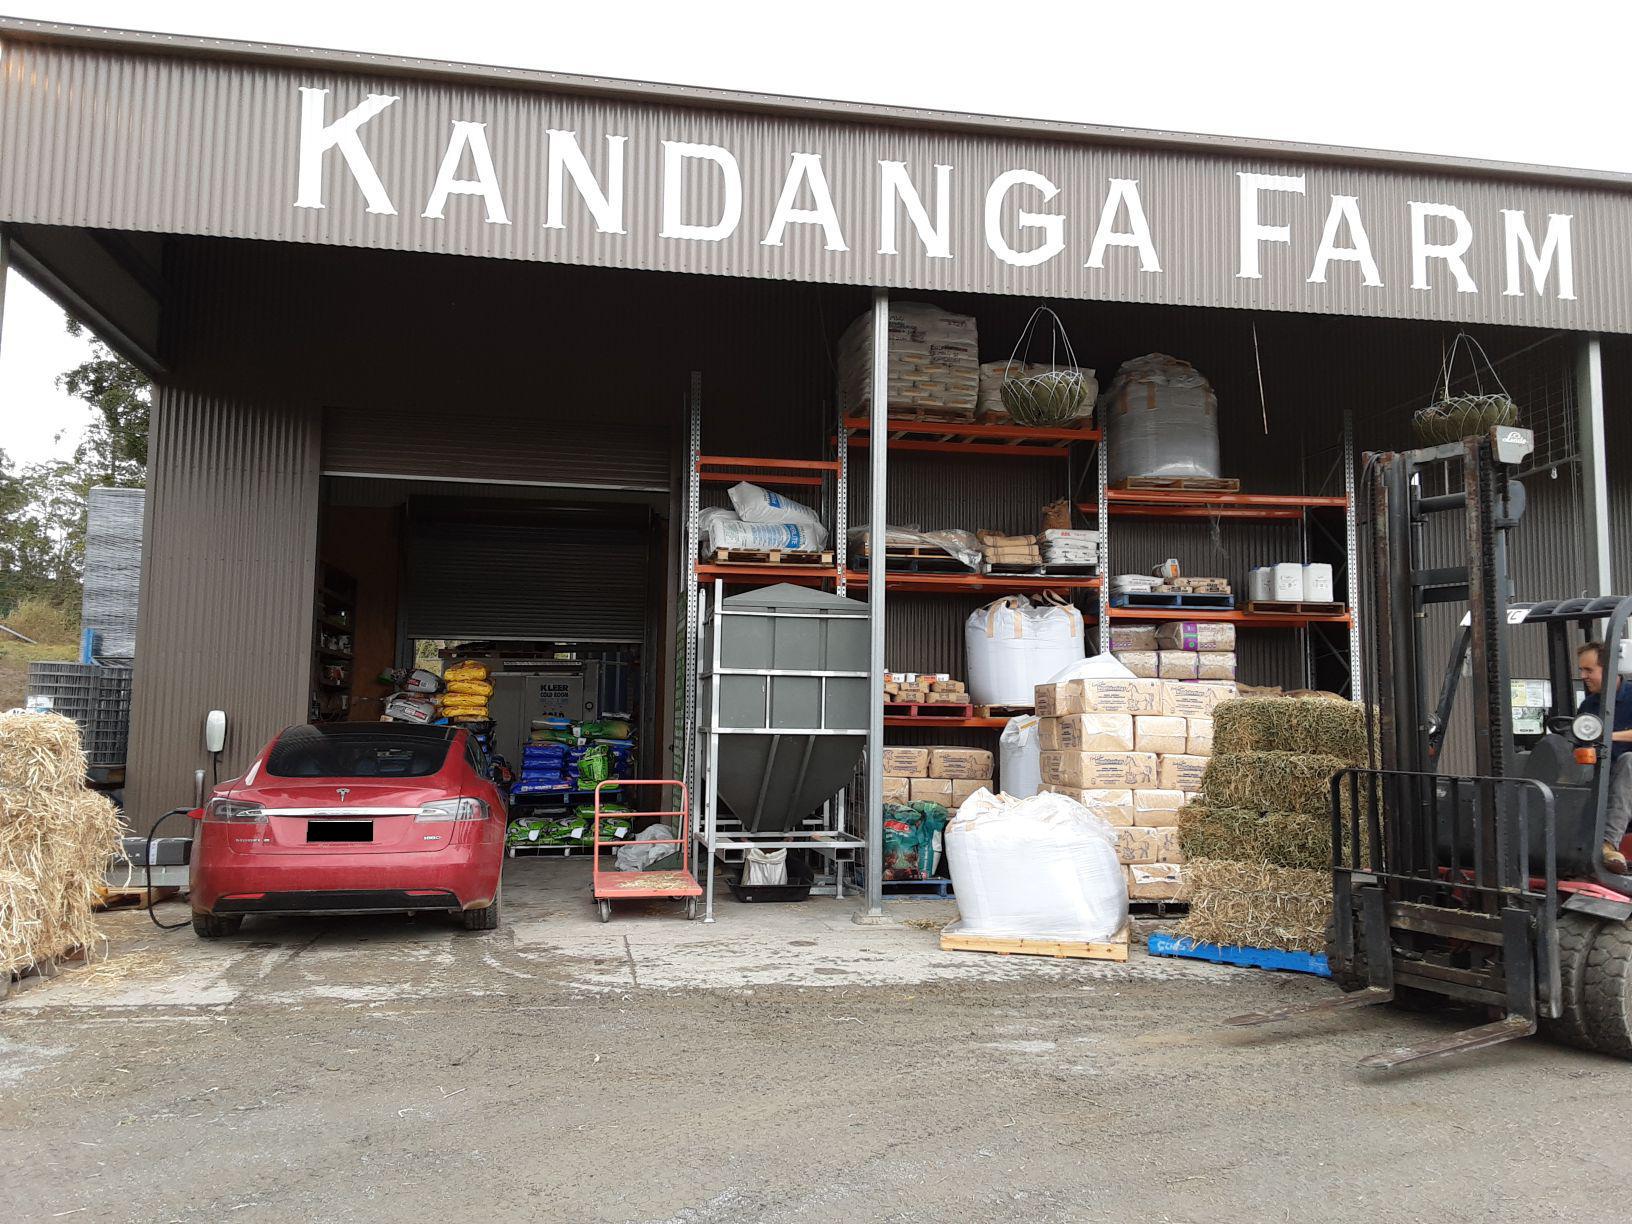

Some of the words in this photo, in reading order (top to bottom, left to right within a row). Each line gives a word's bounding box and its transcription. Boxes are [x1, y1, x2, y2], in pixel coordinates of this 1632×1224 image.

[293, 86, 1163, 273] KANDANGA
[1235, 171, 1578, 300] FARM
[540, 684, 569, 692] KLEER
